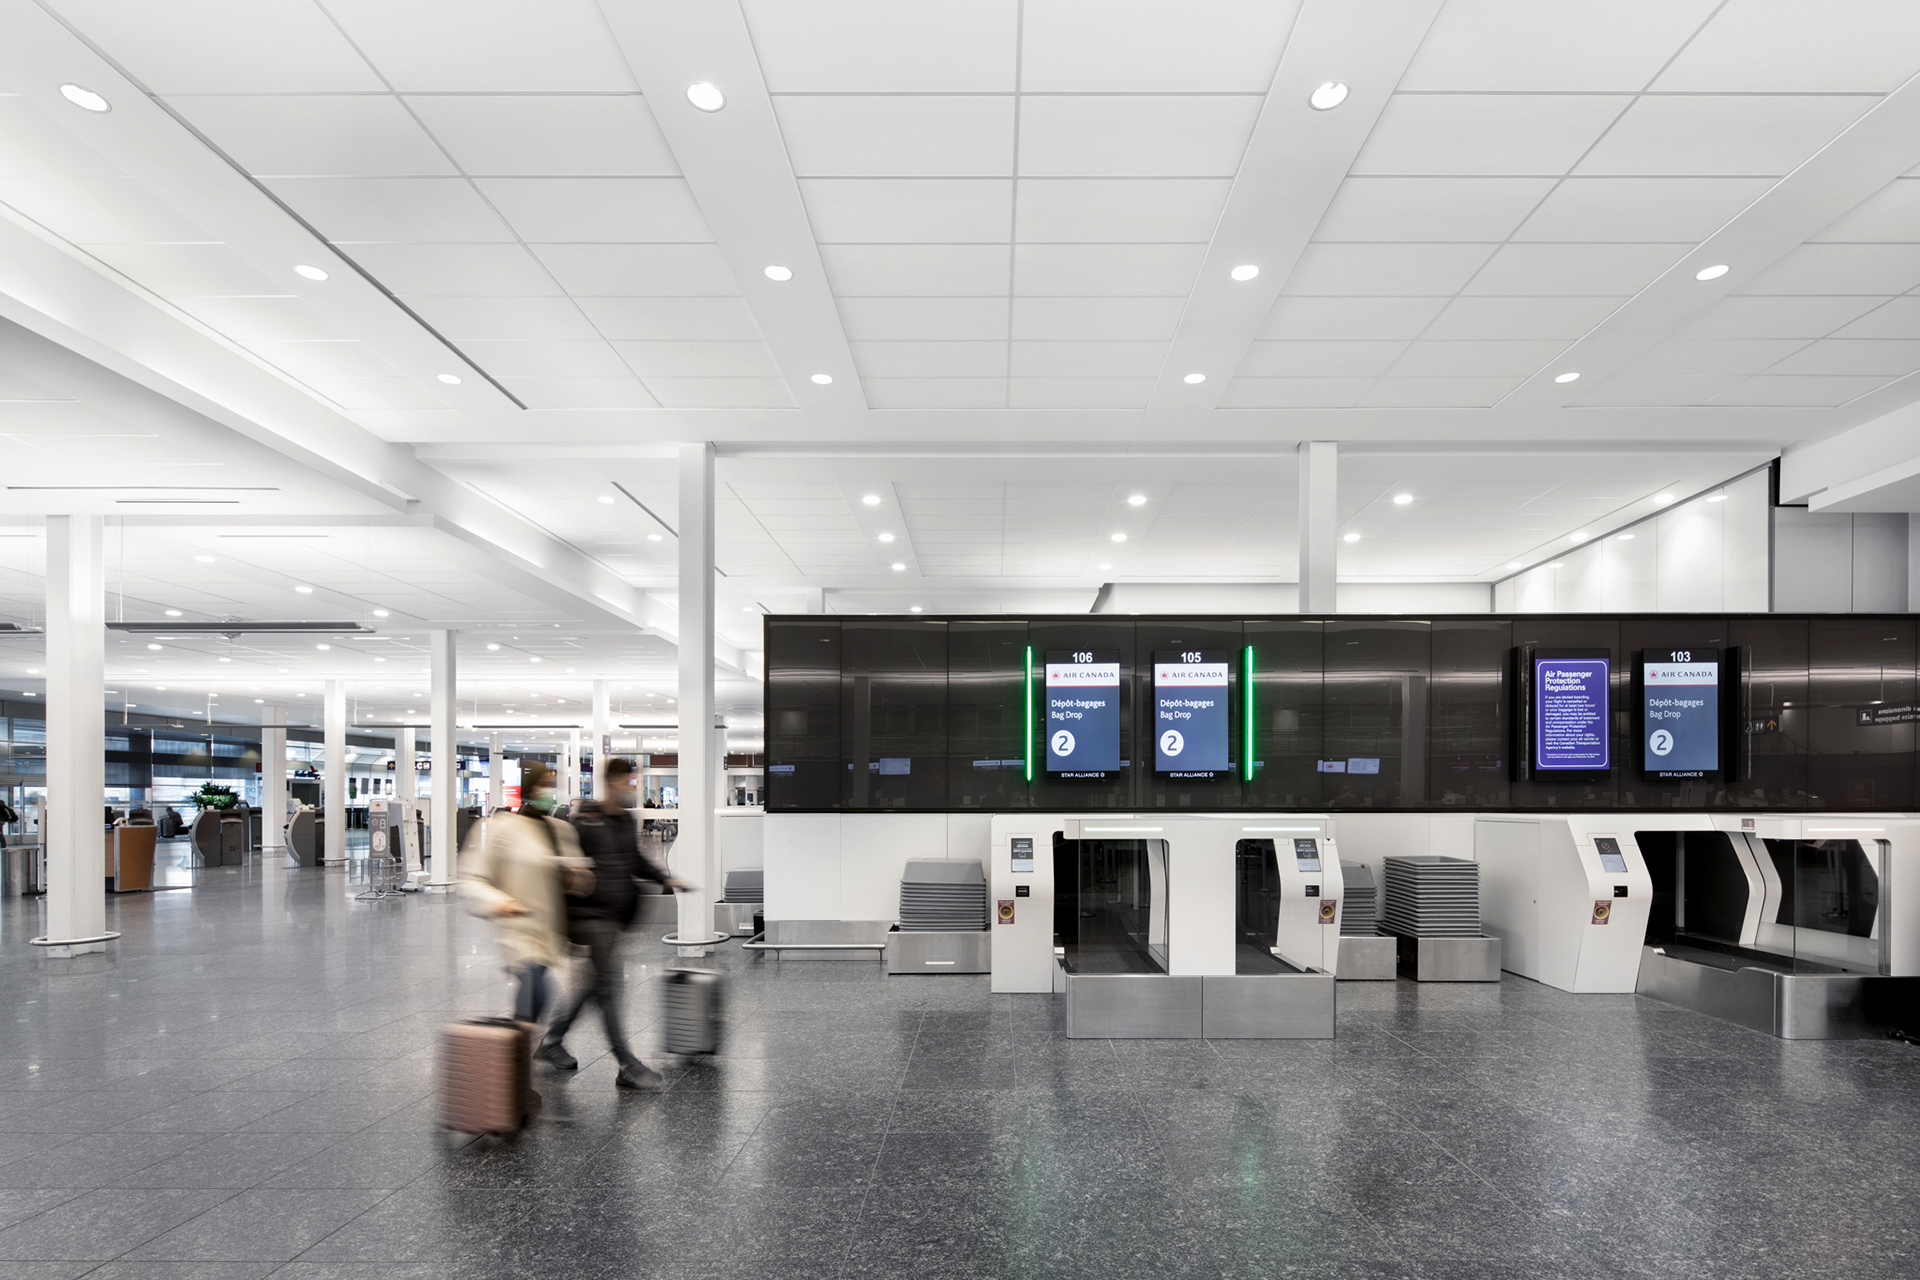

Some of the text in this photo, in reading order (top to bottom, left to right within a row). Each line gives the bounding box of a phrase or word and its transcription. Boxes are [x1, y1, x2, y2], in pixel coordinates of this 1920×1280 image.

[1072, 652, 1093, 663] 106
[1181, 652, 1202, 663] 105
[1670, 651, 1691, 662] 103
[1545, 670, 1592, 679] Air Passenger
[1545, 684, 1586, 692] Regulations
[1051, 699, 1106, 709] Dépôt-bagages
[1160, 699, 1214, 709] Dépôt-bagages
[1649, 698, 1704, 709] Dépôt-bagages
[1051, 711, 1083, 721] Bag Drop
[1160, 710, 1192, 720] Bag Drop
[1649, 710, 1681, 720] Bag Drop
[1058, 735, 1069, 751] 2
[1167, 735, 1177, 751] 2
[1656, 734, 1667, 751] 2
